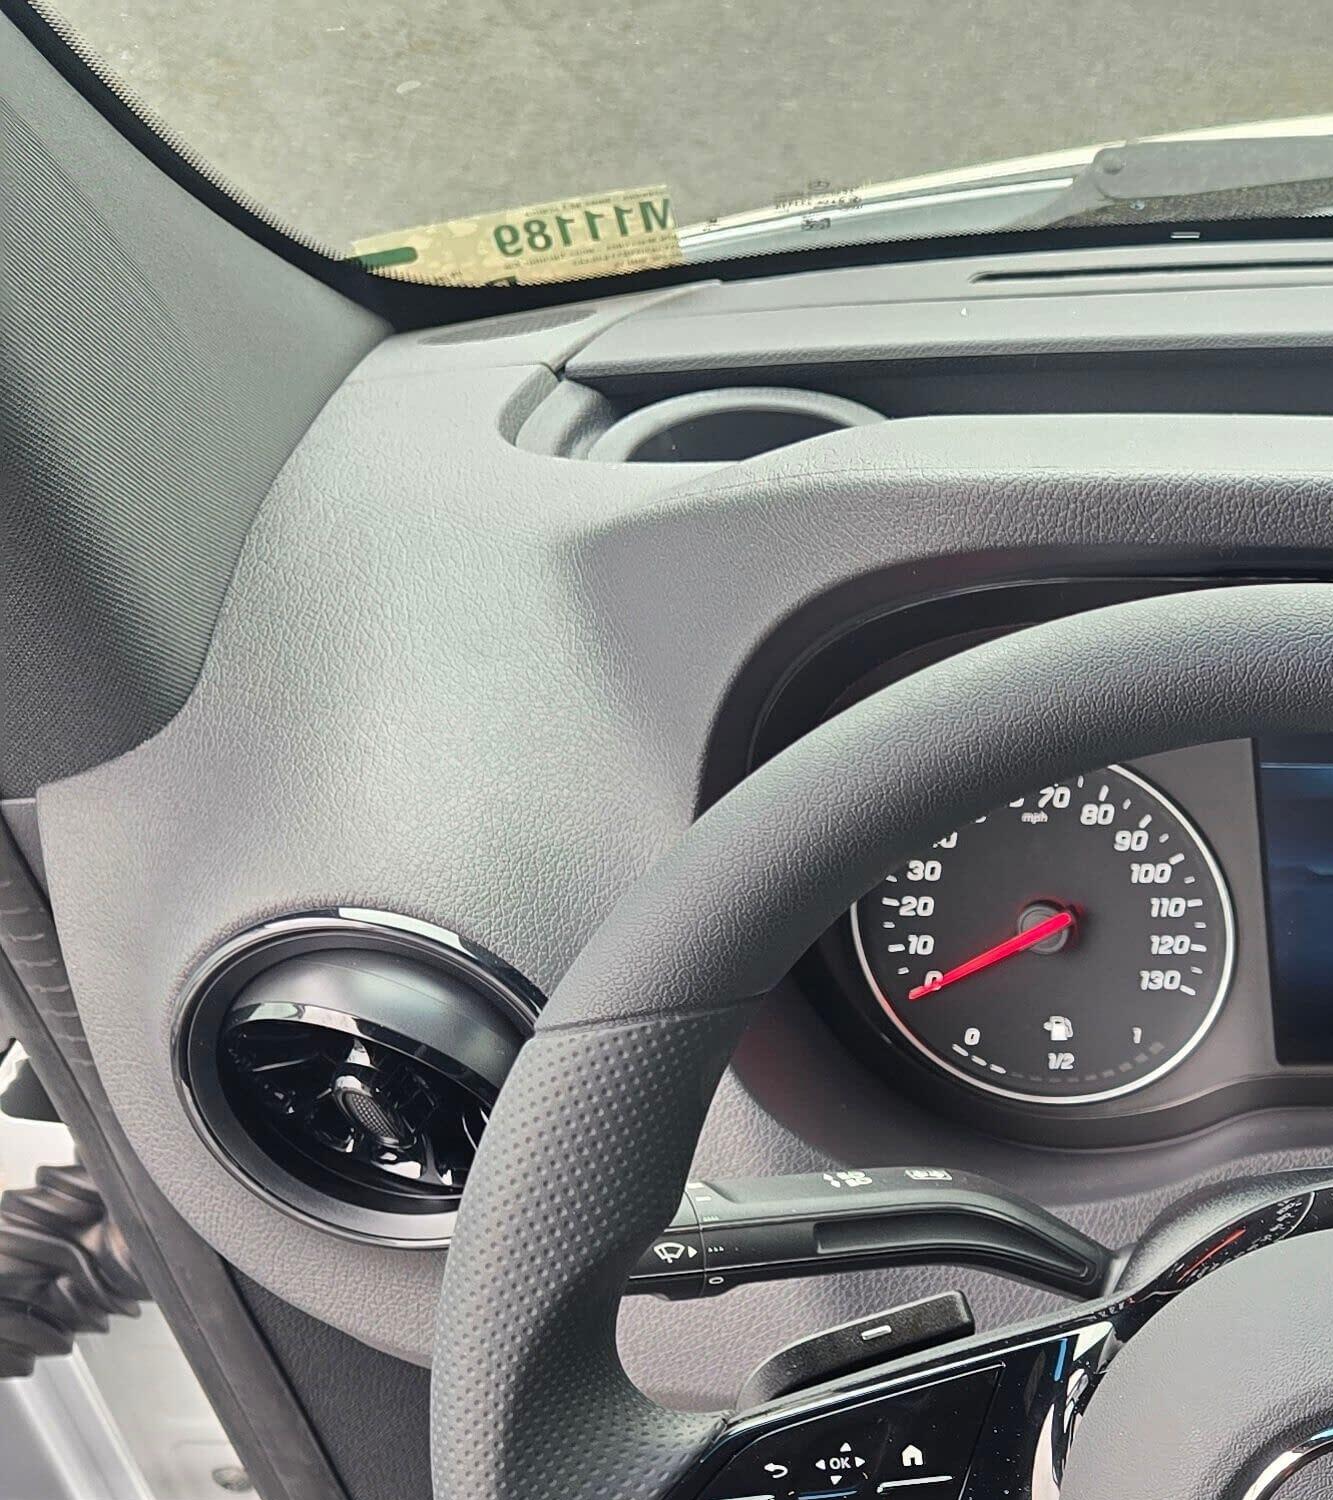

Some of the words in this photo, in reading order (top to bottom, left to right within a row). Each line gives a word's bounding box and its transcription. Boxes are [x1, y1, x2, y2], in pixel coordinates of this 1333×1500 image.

[1038, 786, 1070, 808] 70
[1021, 811, 1049, 824] mph
[1080, 804, 1115, 825] 80
[1114, 830, 1149, 852] 90
[906, 860, 942, 881] 30
[1130, 862, 1171, 884] 100
[899, 896, 935, 917] 20
[1150, 897, 1186, 917] 110
[907, 934, 934, 955] 10
[1150, 934, 1190, 955] 120
[1139, 970, 1180, 991] 130
[964, 1027, 981, 1046] 0
[1132, 1026, 1142, 1044] 1
[1047, 1052, 1075, 1070] 1/2
[829, 1456, 851, 1470] OK
